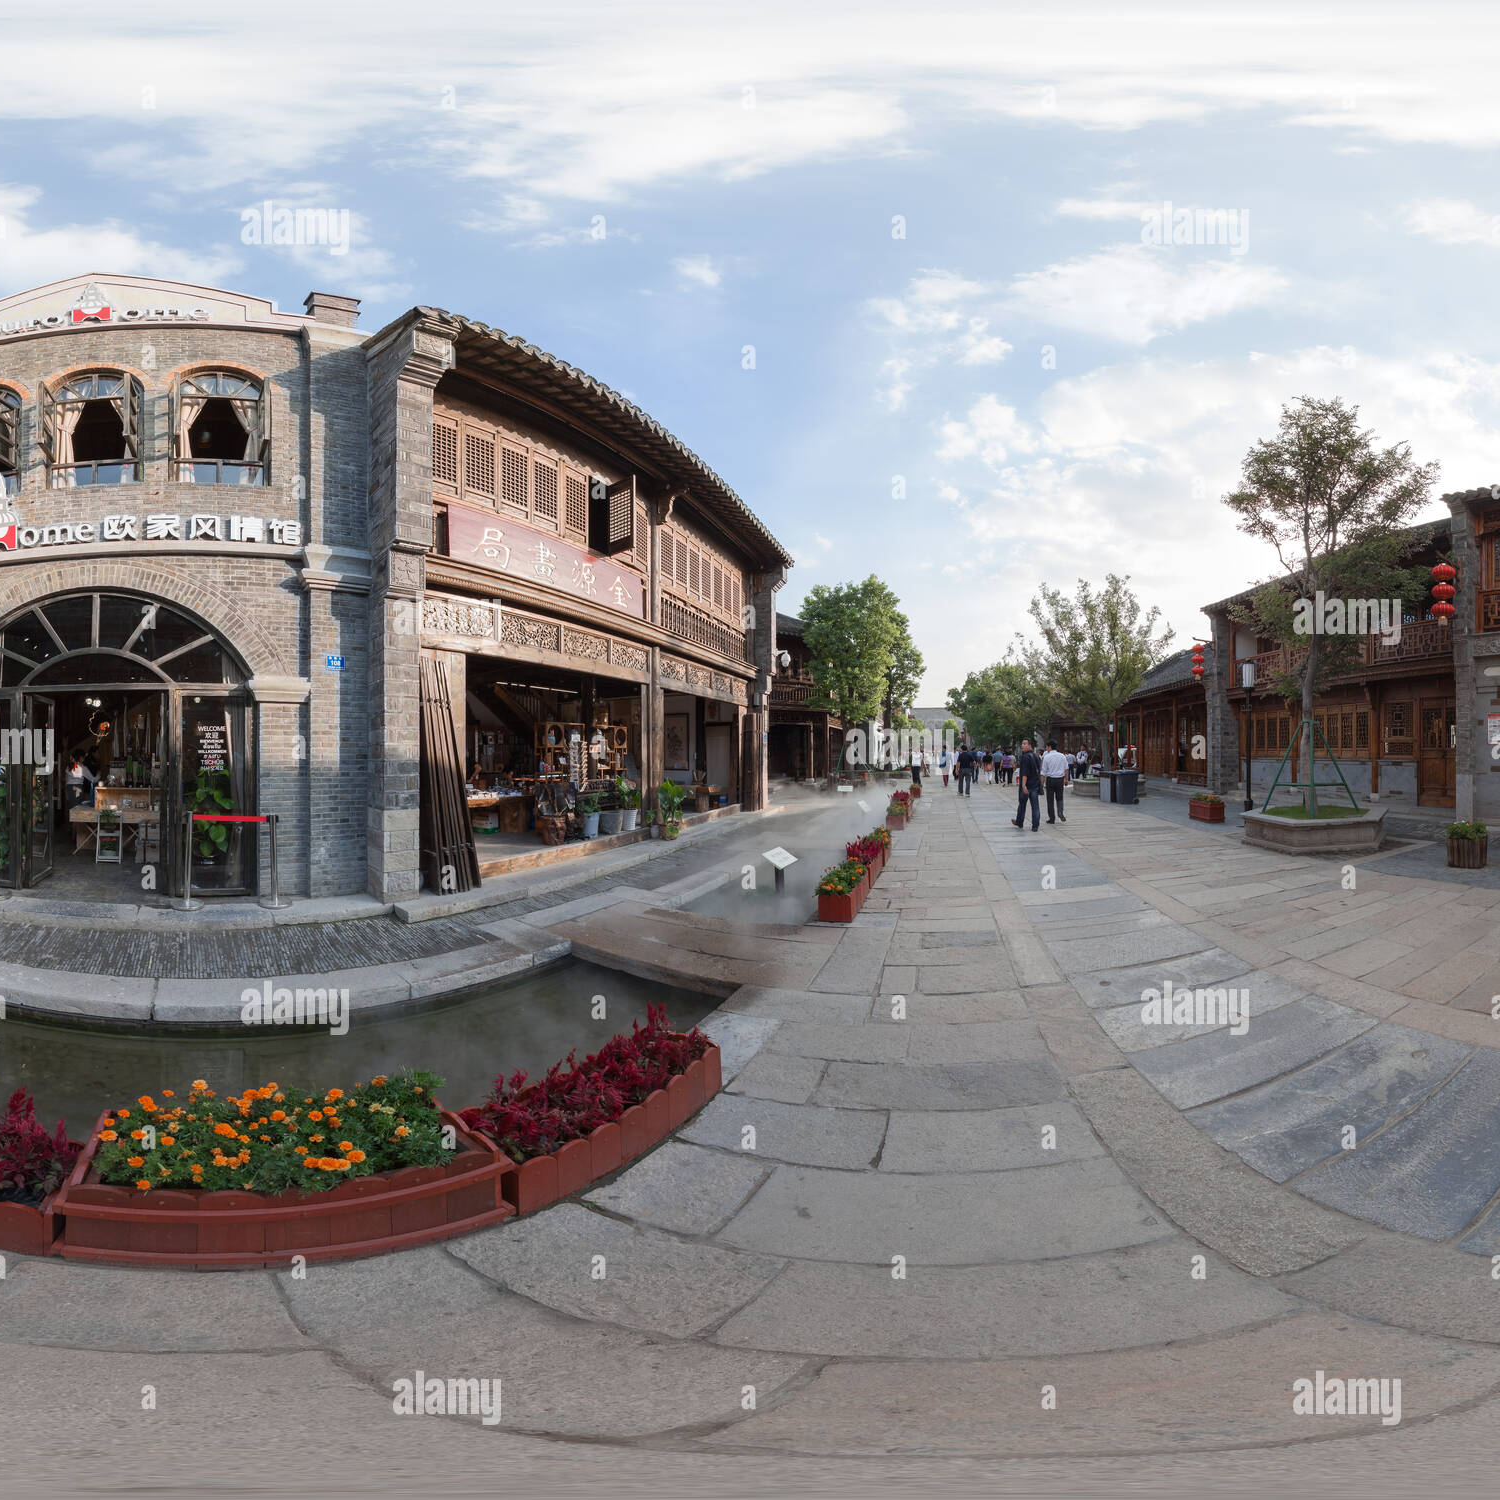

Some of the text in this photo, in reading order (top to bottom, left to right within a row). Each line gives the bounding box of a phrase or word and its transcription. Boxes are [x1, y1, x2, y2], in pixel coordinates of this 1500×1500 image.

[102, 513, 301, 546] 欧家风情馆
